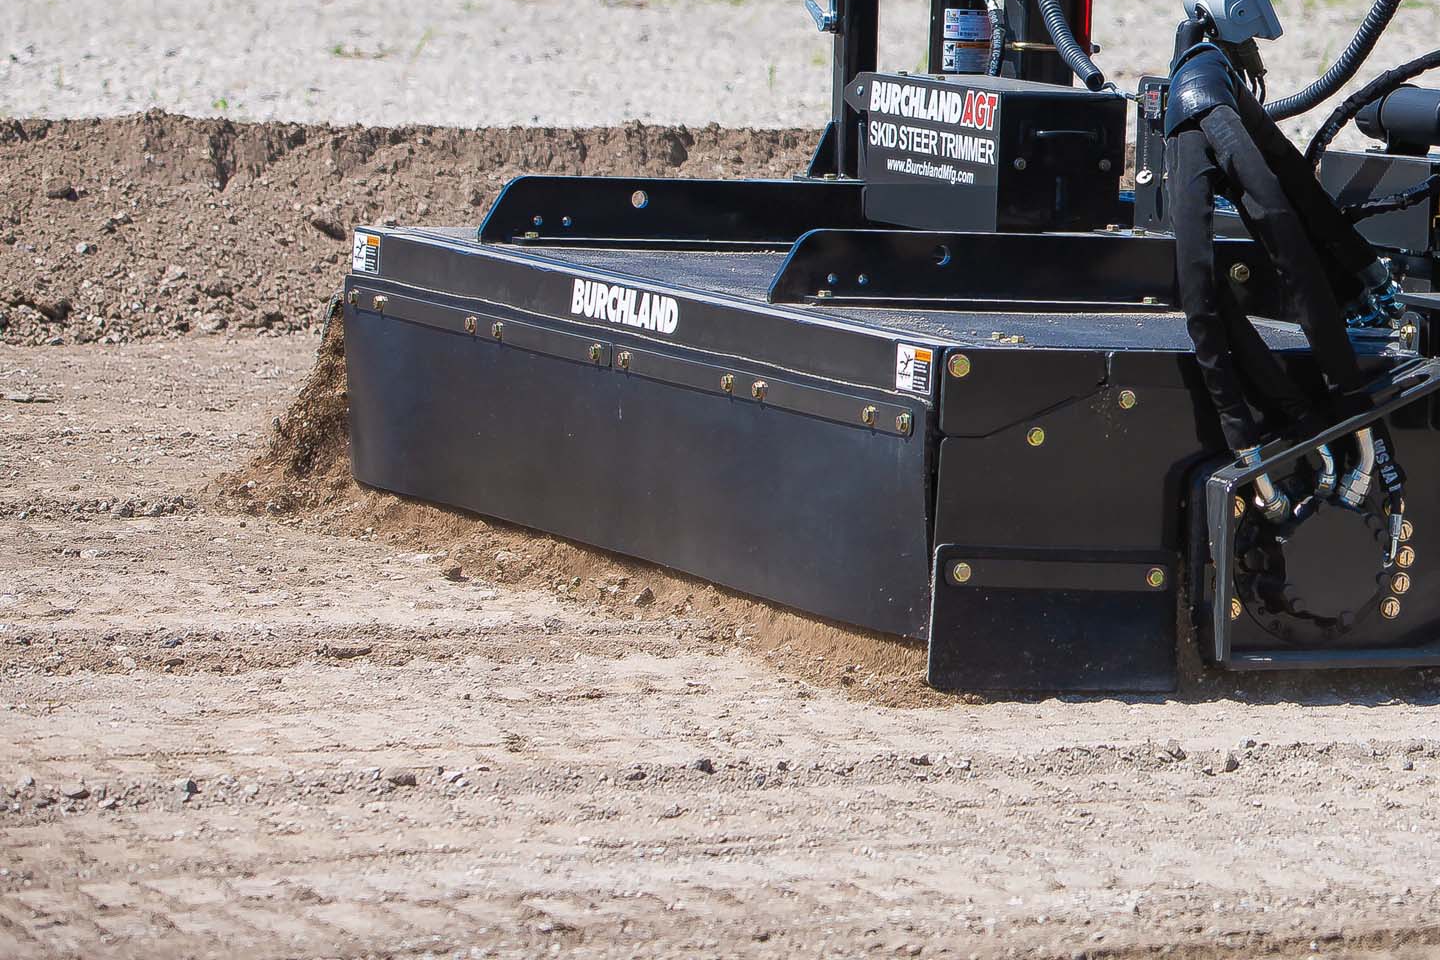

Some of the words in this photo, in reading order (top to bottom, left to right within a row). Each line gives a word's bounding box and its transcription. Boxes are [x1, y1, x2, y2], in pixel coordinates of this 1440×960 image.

[870, 120, 898, 147] SKID
[898, 125, 938, 155] STEER
[940, 131, 995, 165] TRIMMER
[887, 158, 974, 184] www.BurchlandMfg.com
[571, 278, 679, 334] BURCHLAND
